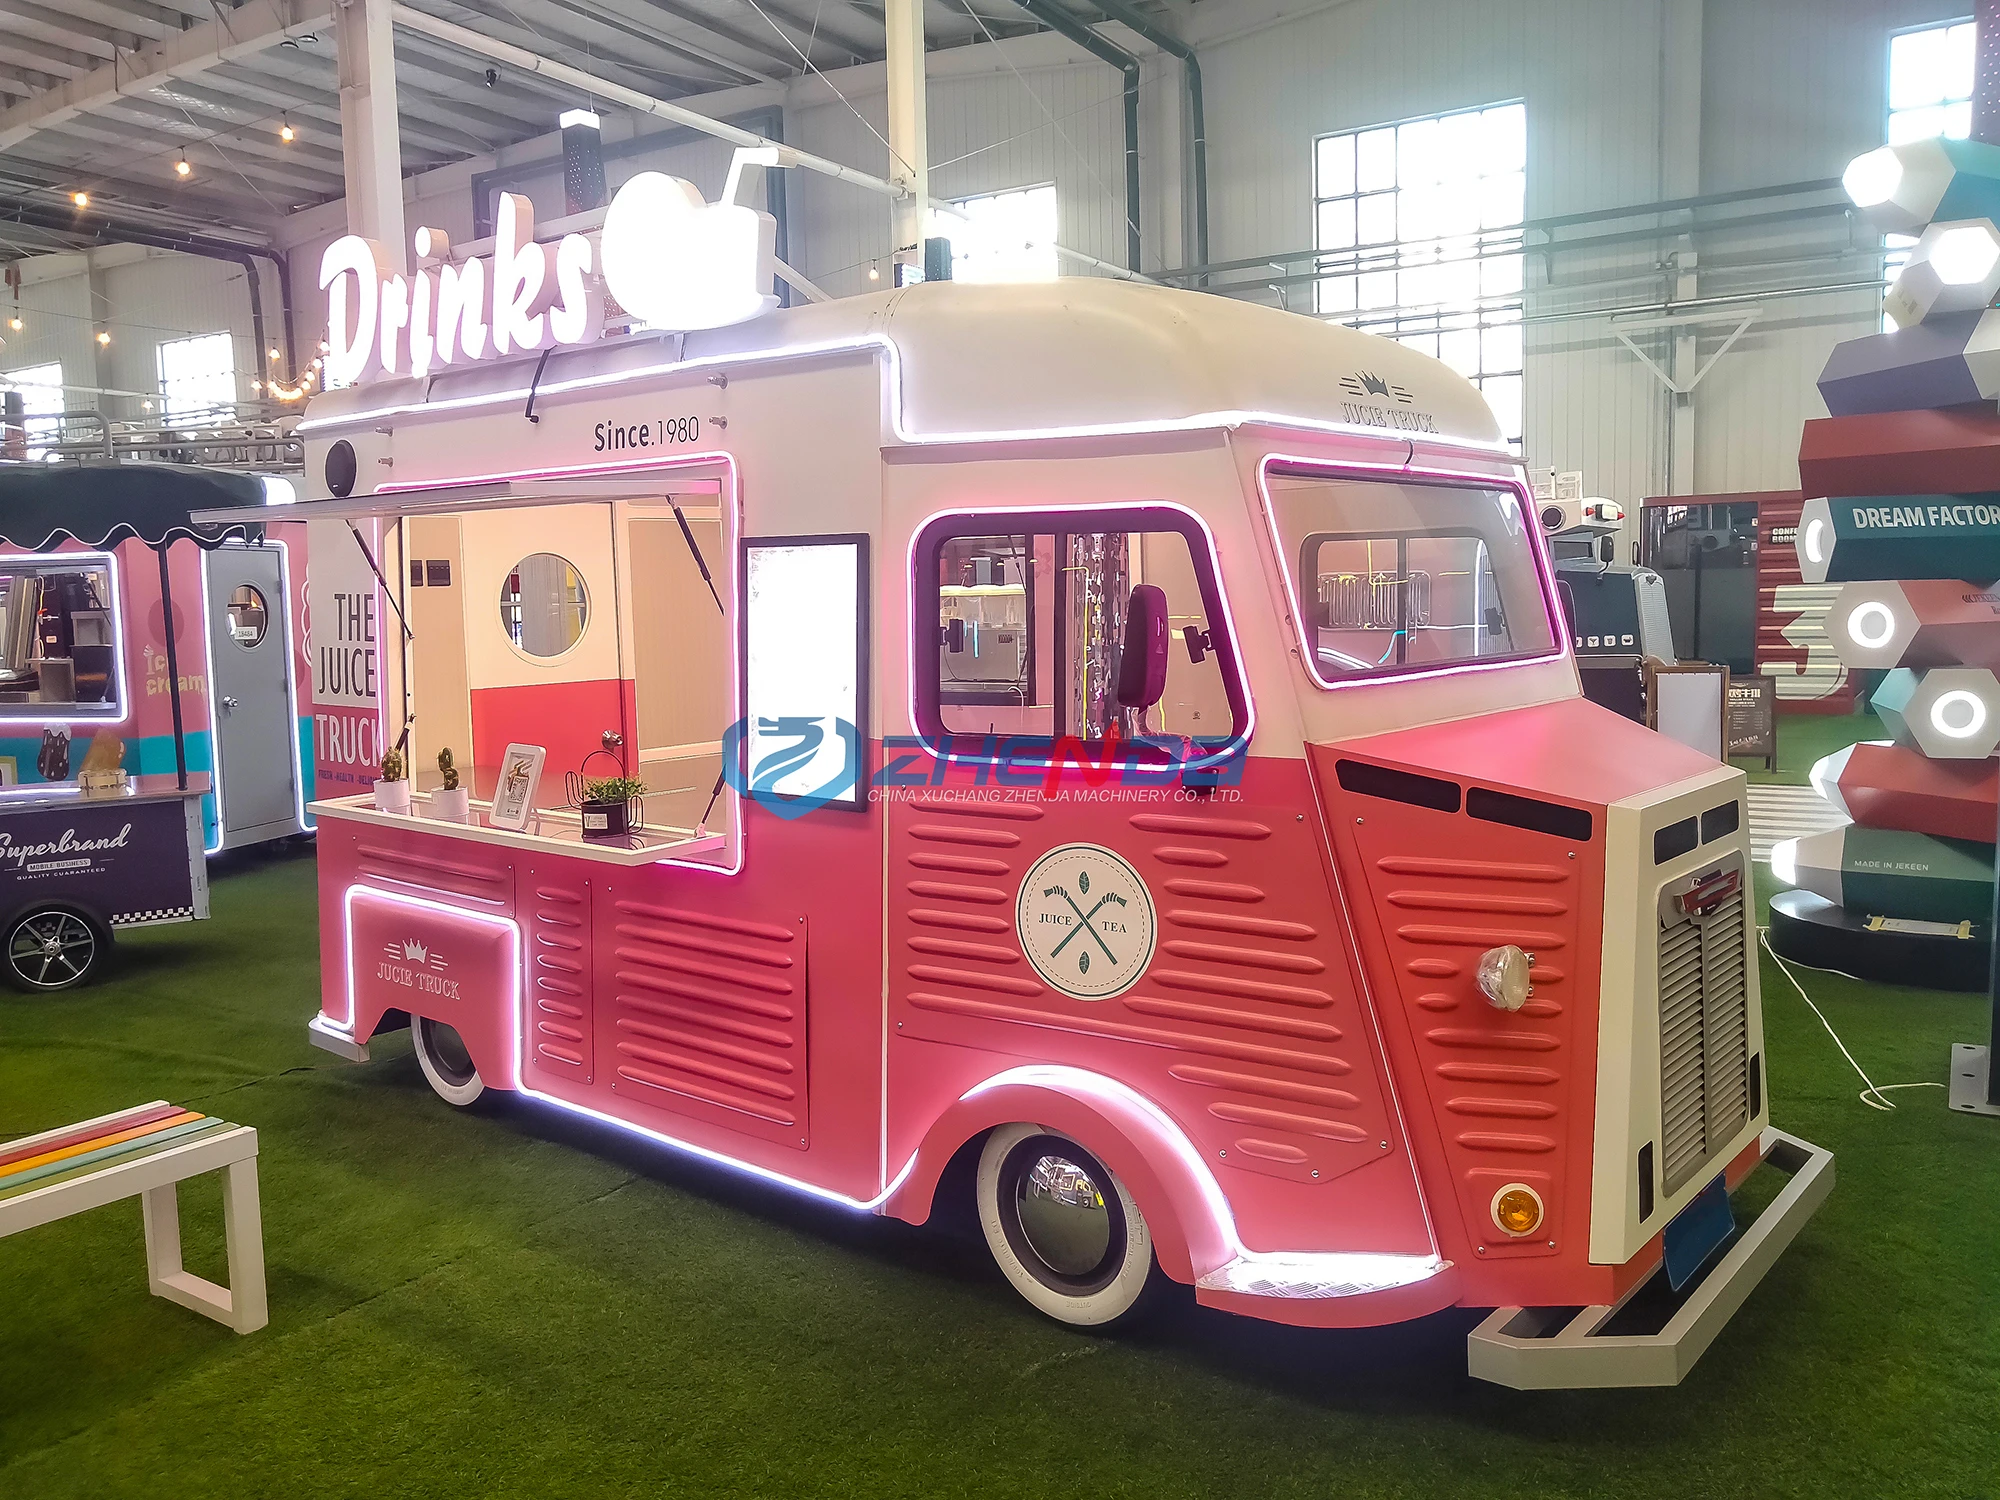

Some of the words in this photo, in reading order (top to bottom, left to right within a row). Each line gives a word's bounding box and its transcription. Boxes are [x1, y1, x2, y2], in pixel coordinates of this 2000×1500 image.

[318, 191, 597, 384] Drinks
[1340, 401, 1387, 428] JUCIE
[1387, 407, 1440, 434] TRUCK
[1852, 507, 1926, 529] DREAM
[334, 593, 375, 642] THE
[319, 646, 376, 698] JUICE
[0, 823, 132, 867] Superbrand
[16, 873, 50, 881] QUALITY
[29, 863, 54, 871] MOBILE
[56, 859, 88, 868] BUSINESS
[1854, 860, 1880, 868] MADE
[1895, 862, 1929, 871] JEKEEN
[1038, 913, 1073, 926] JUICE
[1101, 921, 1128, 933] TEA
[377, 962, 413, 987] JUCIE
[415, 972, 460, 1000] TRUCK
